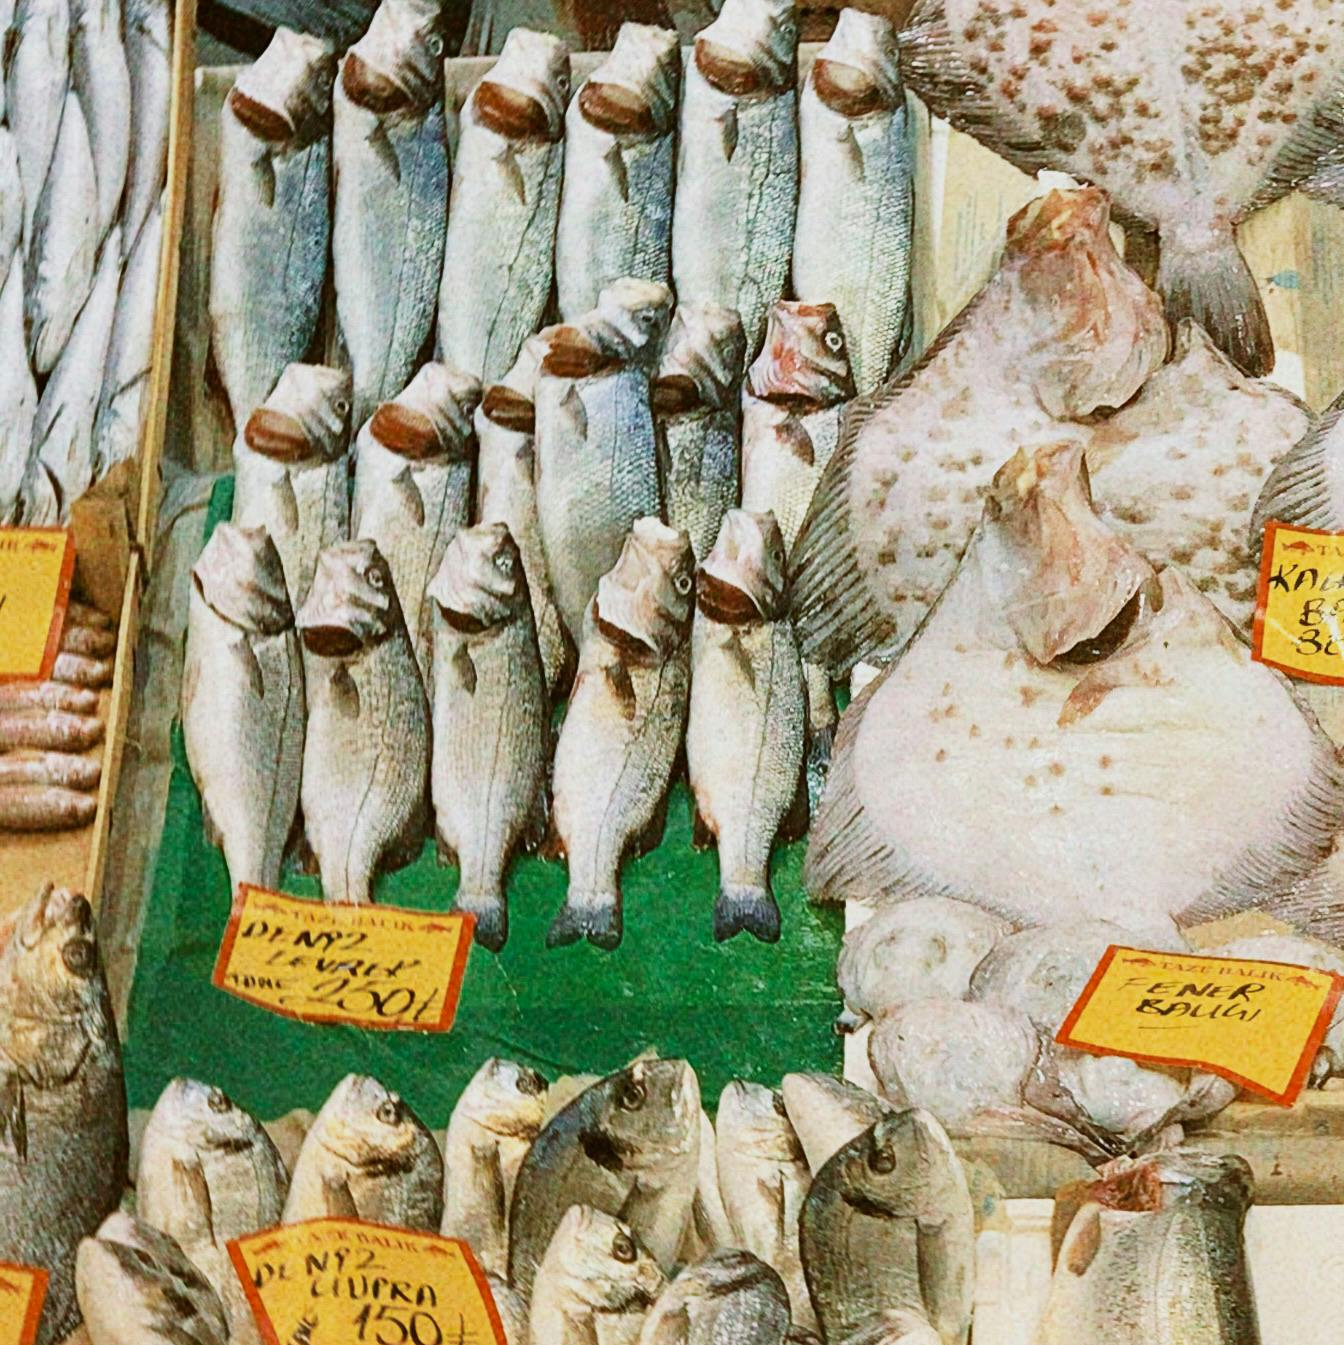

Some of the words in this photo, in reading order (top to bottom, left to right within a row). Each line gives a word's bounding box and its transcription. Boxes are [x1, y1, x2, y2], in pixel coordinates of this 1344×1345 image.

[292, 910, 345, 925] TAZE
[1160, 961, 1212, 974] TAZE
[1219, 967, 1284, 981] BALIK
[1118, 977, 1266, 1002] FENER
[356, 1233, 419, 1253] BALIK
